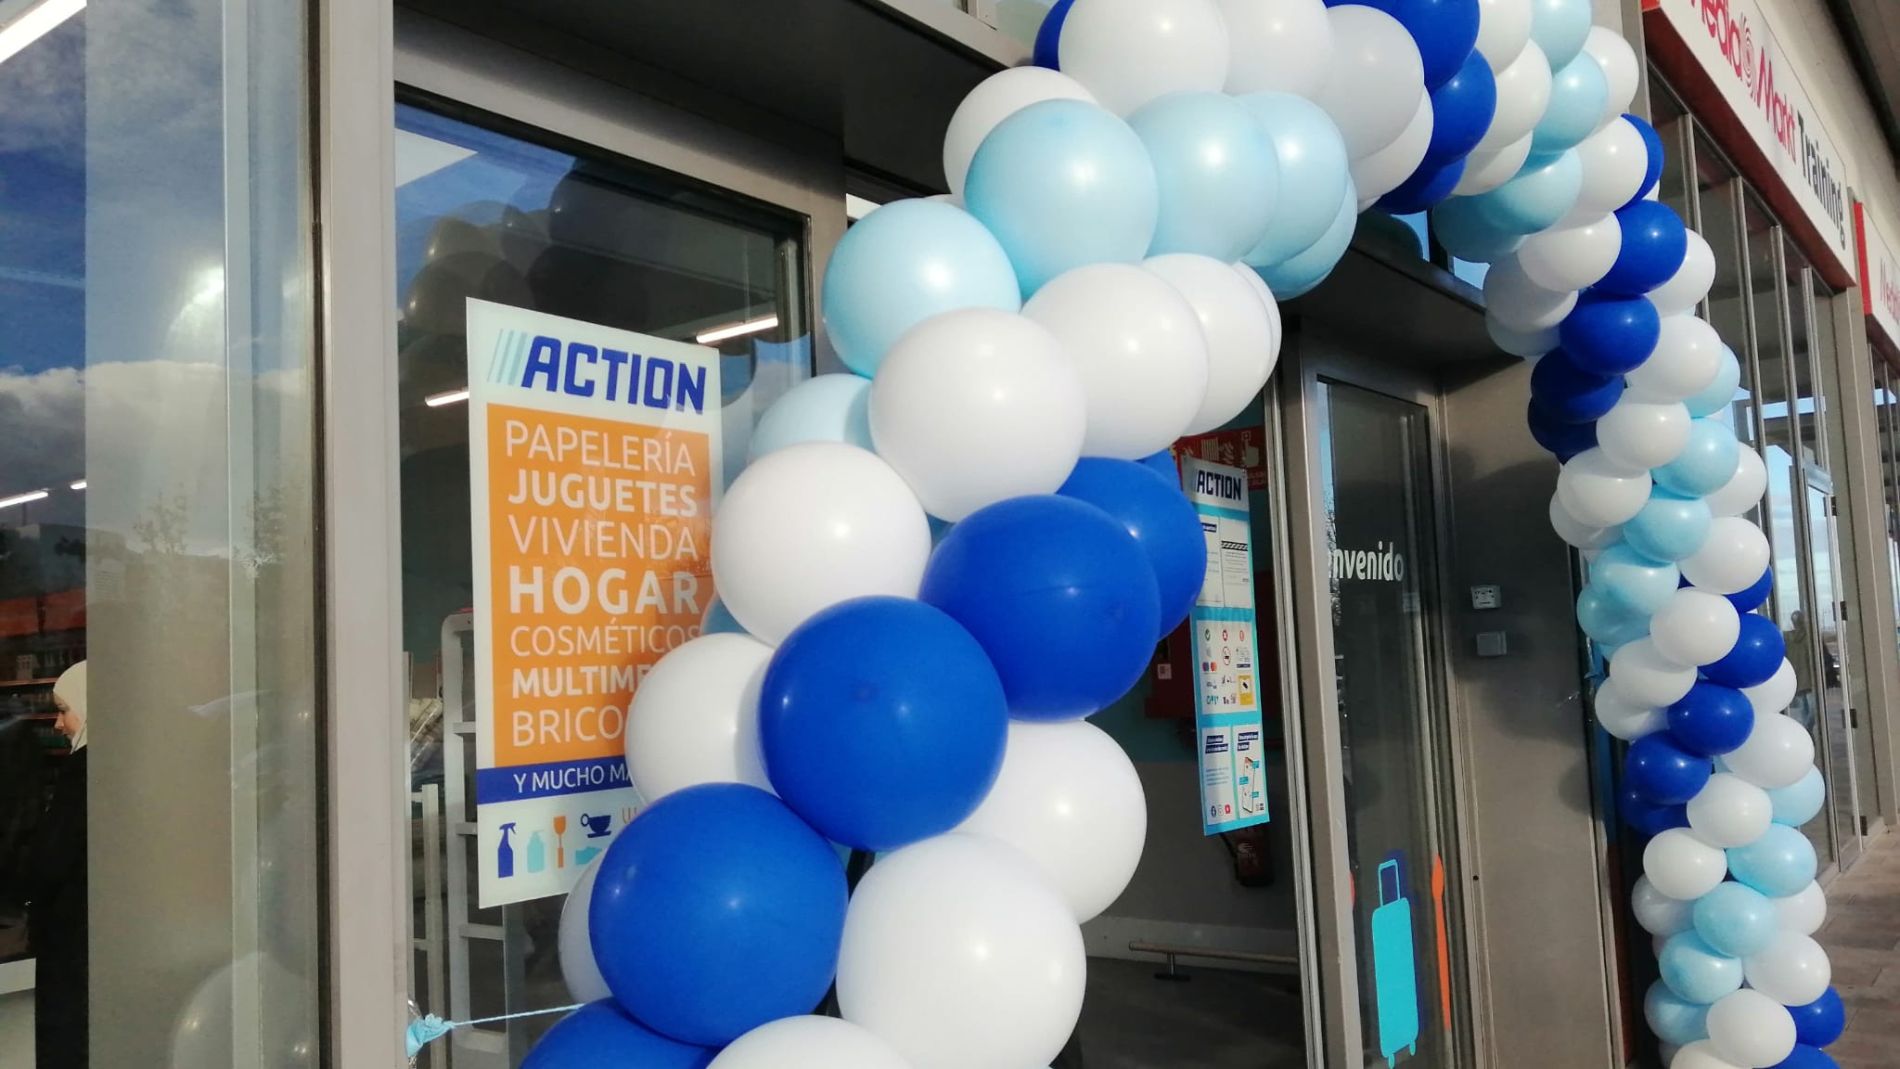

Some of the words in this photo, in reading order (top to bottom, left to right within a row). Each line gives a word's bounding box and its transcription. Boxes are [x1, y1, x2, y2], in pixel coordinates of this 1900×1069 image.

[1690, 0, 1743, 81] edia
[1757, 46, 1796, 165] Markt
[1797, 109, 1846, 251] Training
[521, 335, 707, 415] ACTION
[506, 419, 696, 477] PAPELERÍA
[508, 468, 698, 518] JUGUETES
[1196, 469, 1242, 500] ACTION
[508, 514, 699, 561] VIVIENDA
[1328, 540, 1404, 582] nvenido
[508, 564, 700, 615] HOGAR
[512, 704, 632, 747] BRICO
[513, 773, 527, 793] Y
[532, 764, 605, 792] MUCHO
